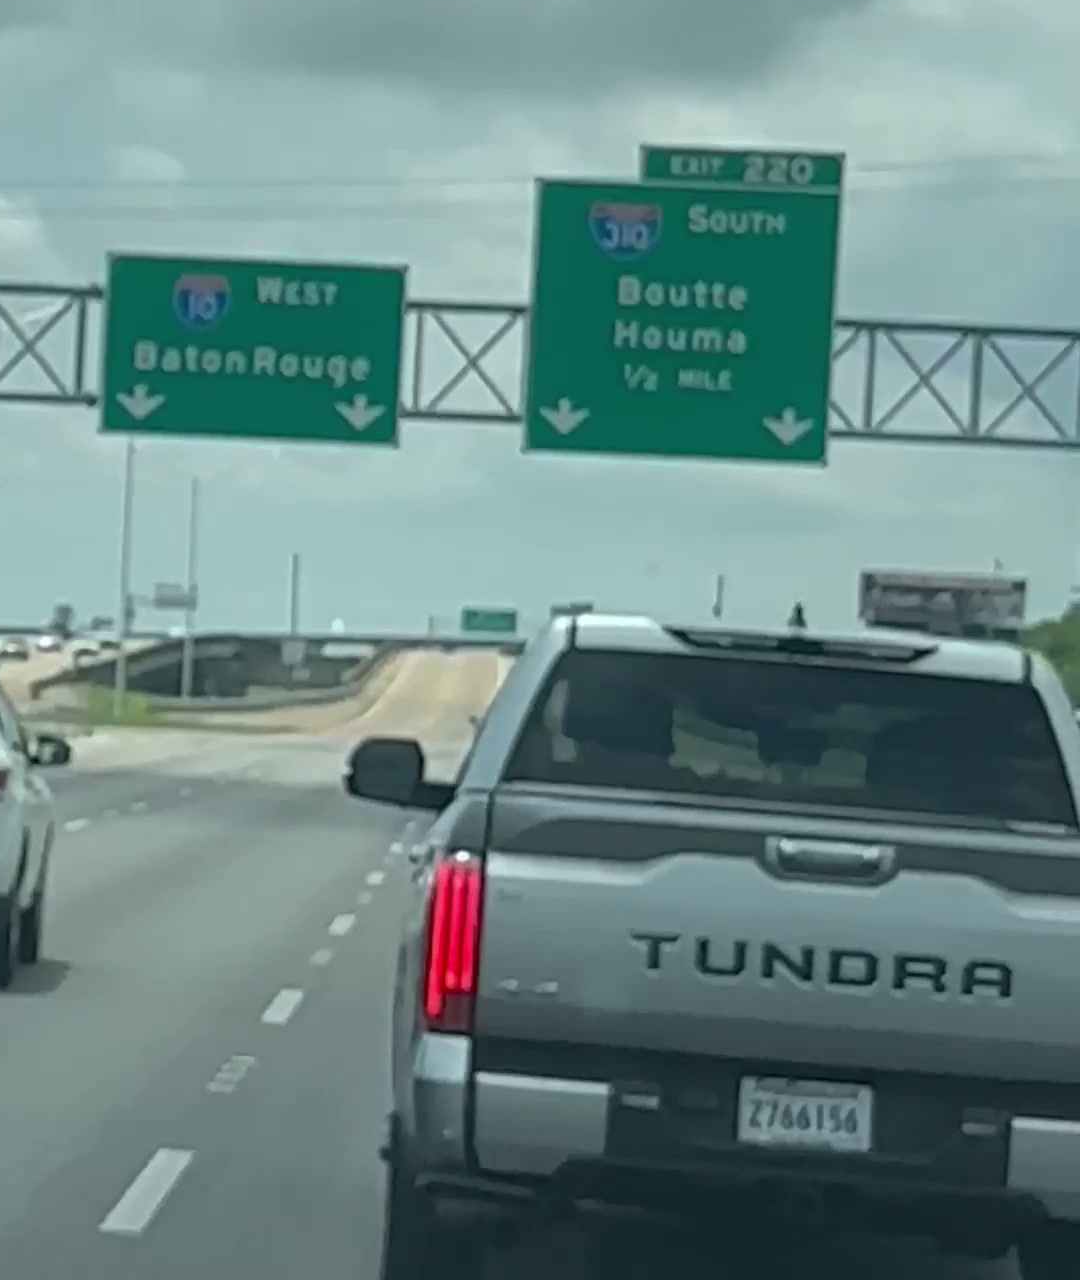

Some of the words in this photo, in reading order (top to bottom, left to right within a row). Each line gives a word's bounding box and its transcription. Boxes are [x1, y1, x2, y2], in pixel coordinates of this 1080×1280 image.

[670, 155, 723, 176] EXIT
[744, 155, 814, 185] 220
[187, 292, 220, 322] 10
[256, 276, 337, 306] WEST
[618, 275, 749, 311] Boutte
[614, 320, 748, 354] Houma
[133, 338, 248, 375] Baton
[253, 346, 370, 389] Rouge
[678, 368, 732, 391] MILE
[630, 930, 1012, 998] TUNDRA
